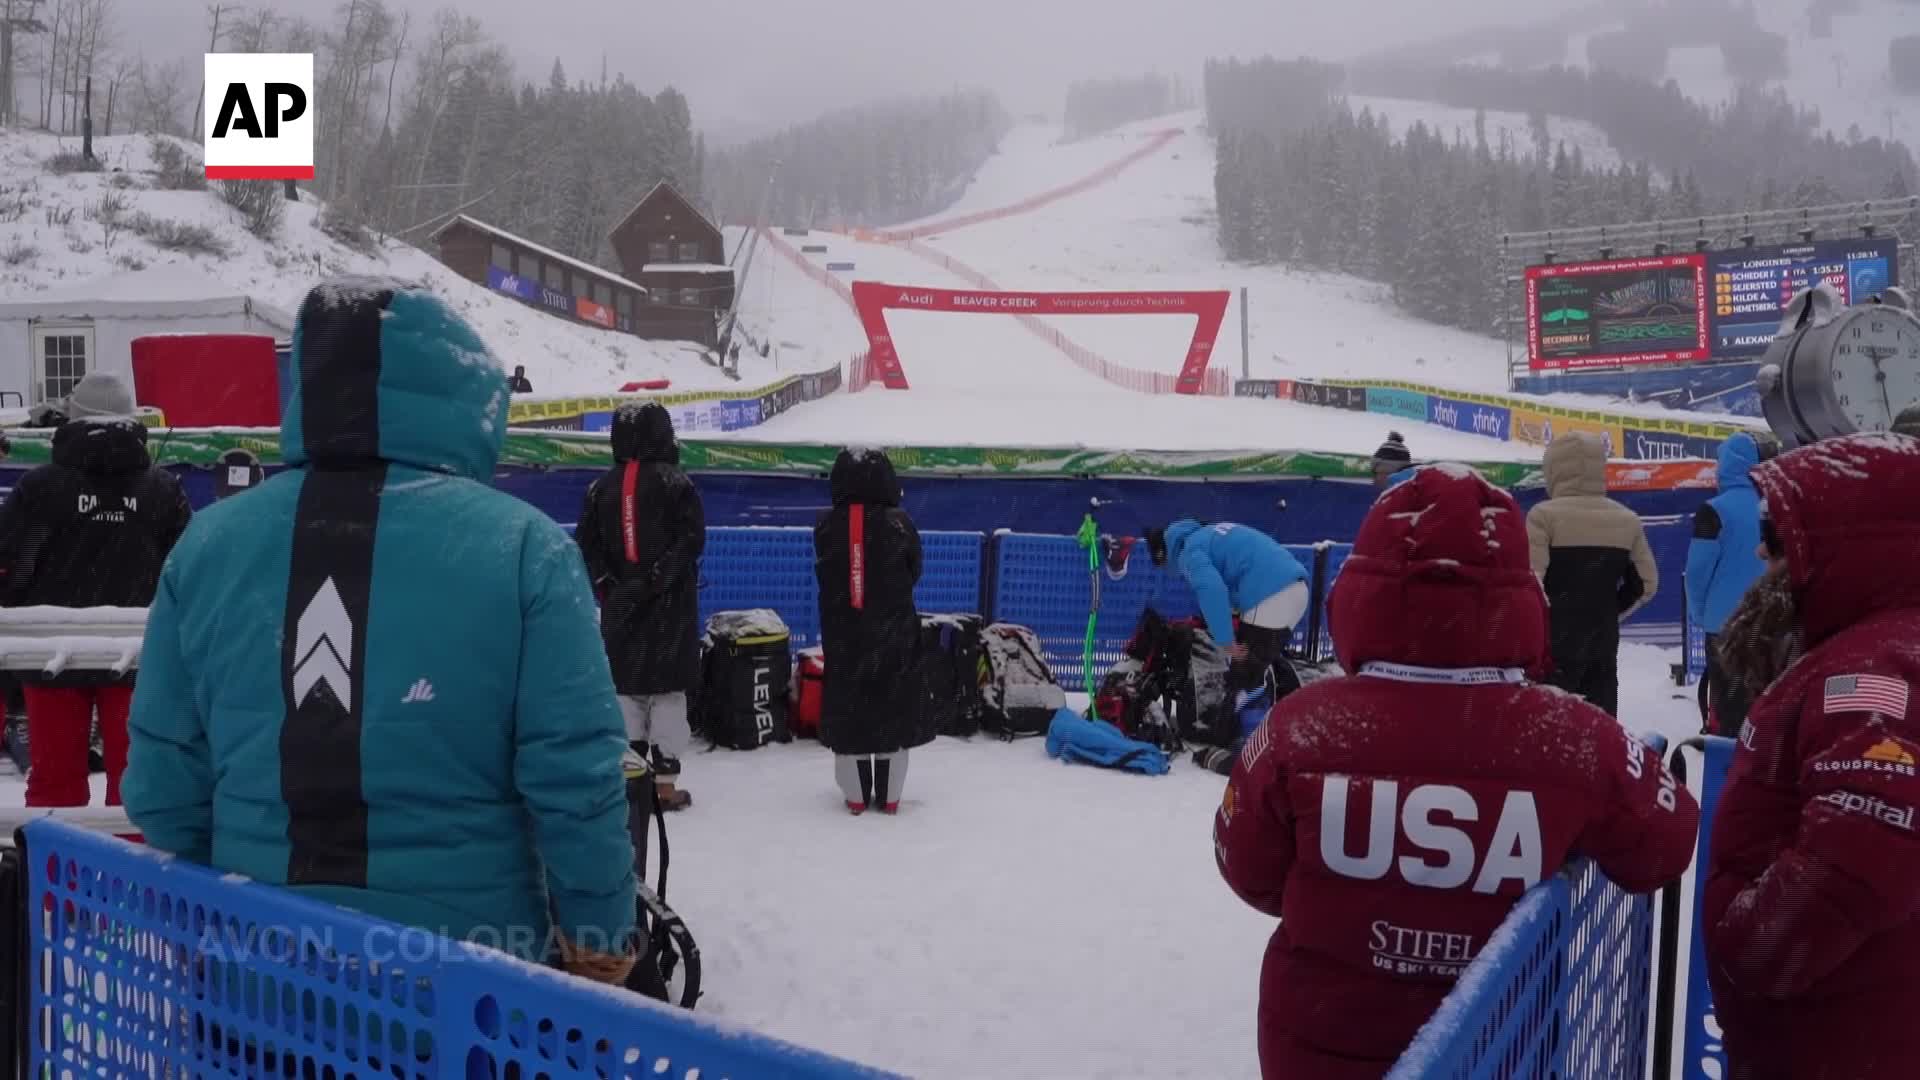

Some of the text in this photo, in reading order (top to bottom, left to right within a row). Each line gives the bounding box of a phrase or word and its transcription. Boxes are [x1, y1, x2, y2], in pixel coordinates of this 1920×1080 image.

[1581, 263, 1617, 273] Vorsprung
[1617, 261, 1637, 269] durch
[1638, 259, 1663, 267] Technik
[1743, 258, 1792, 269] LONGINES
[1732, 270, 1770, 282] SCHIEDER
[1793, 268, 1806, 276] ITA
[1813, 265, 1844, 275] 1:35.37
[1732, 281, 1777, 292] SEJERSTED
[1791, 279, 1808, 287] NOR
[542, 288, 569, 311] STIFEL
[899, 292, 1186, 310] Audi BEAVER CREEK Vorsprung durch Technik
[1733, 293, 1759, 303] KILDE
[1760, 292, 1769, 301] A.
[1542, 335, 1578, 345] DECEMBER
[1852, 327, 1861, 339] 11
[1722, 338, 1728, 346] 5
[1585, 356, 1619, 365] Vorsprung
[1620, 354, 1641, 362] durch
[1641, 353, 1668, 361] Technik
[1434, 401, 1458, 428] xfinity
[1472, 408, 1501, 438] xfinity
[1386, 666, 1409, 677] VALLEY
[754, 668, 774, 745] LEVEL
[1814, 760, 1916, 777] CLOUDFLARE
[1320, 773, 1543, 895] USA
[1369, 920, 1473, 960] STIFEL
[1373, 955, 1464, 977] US SKI TEA
